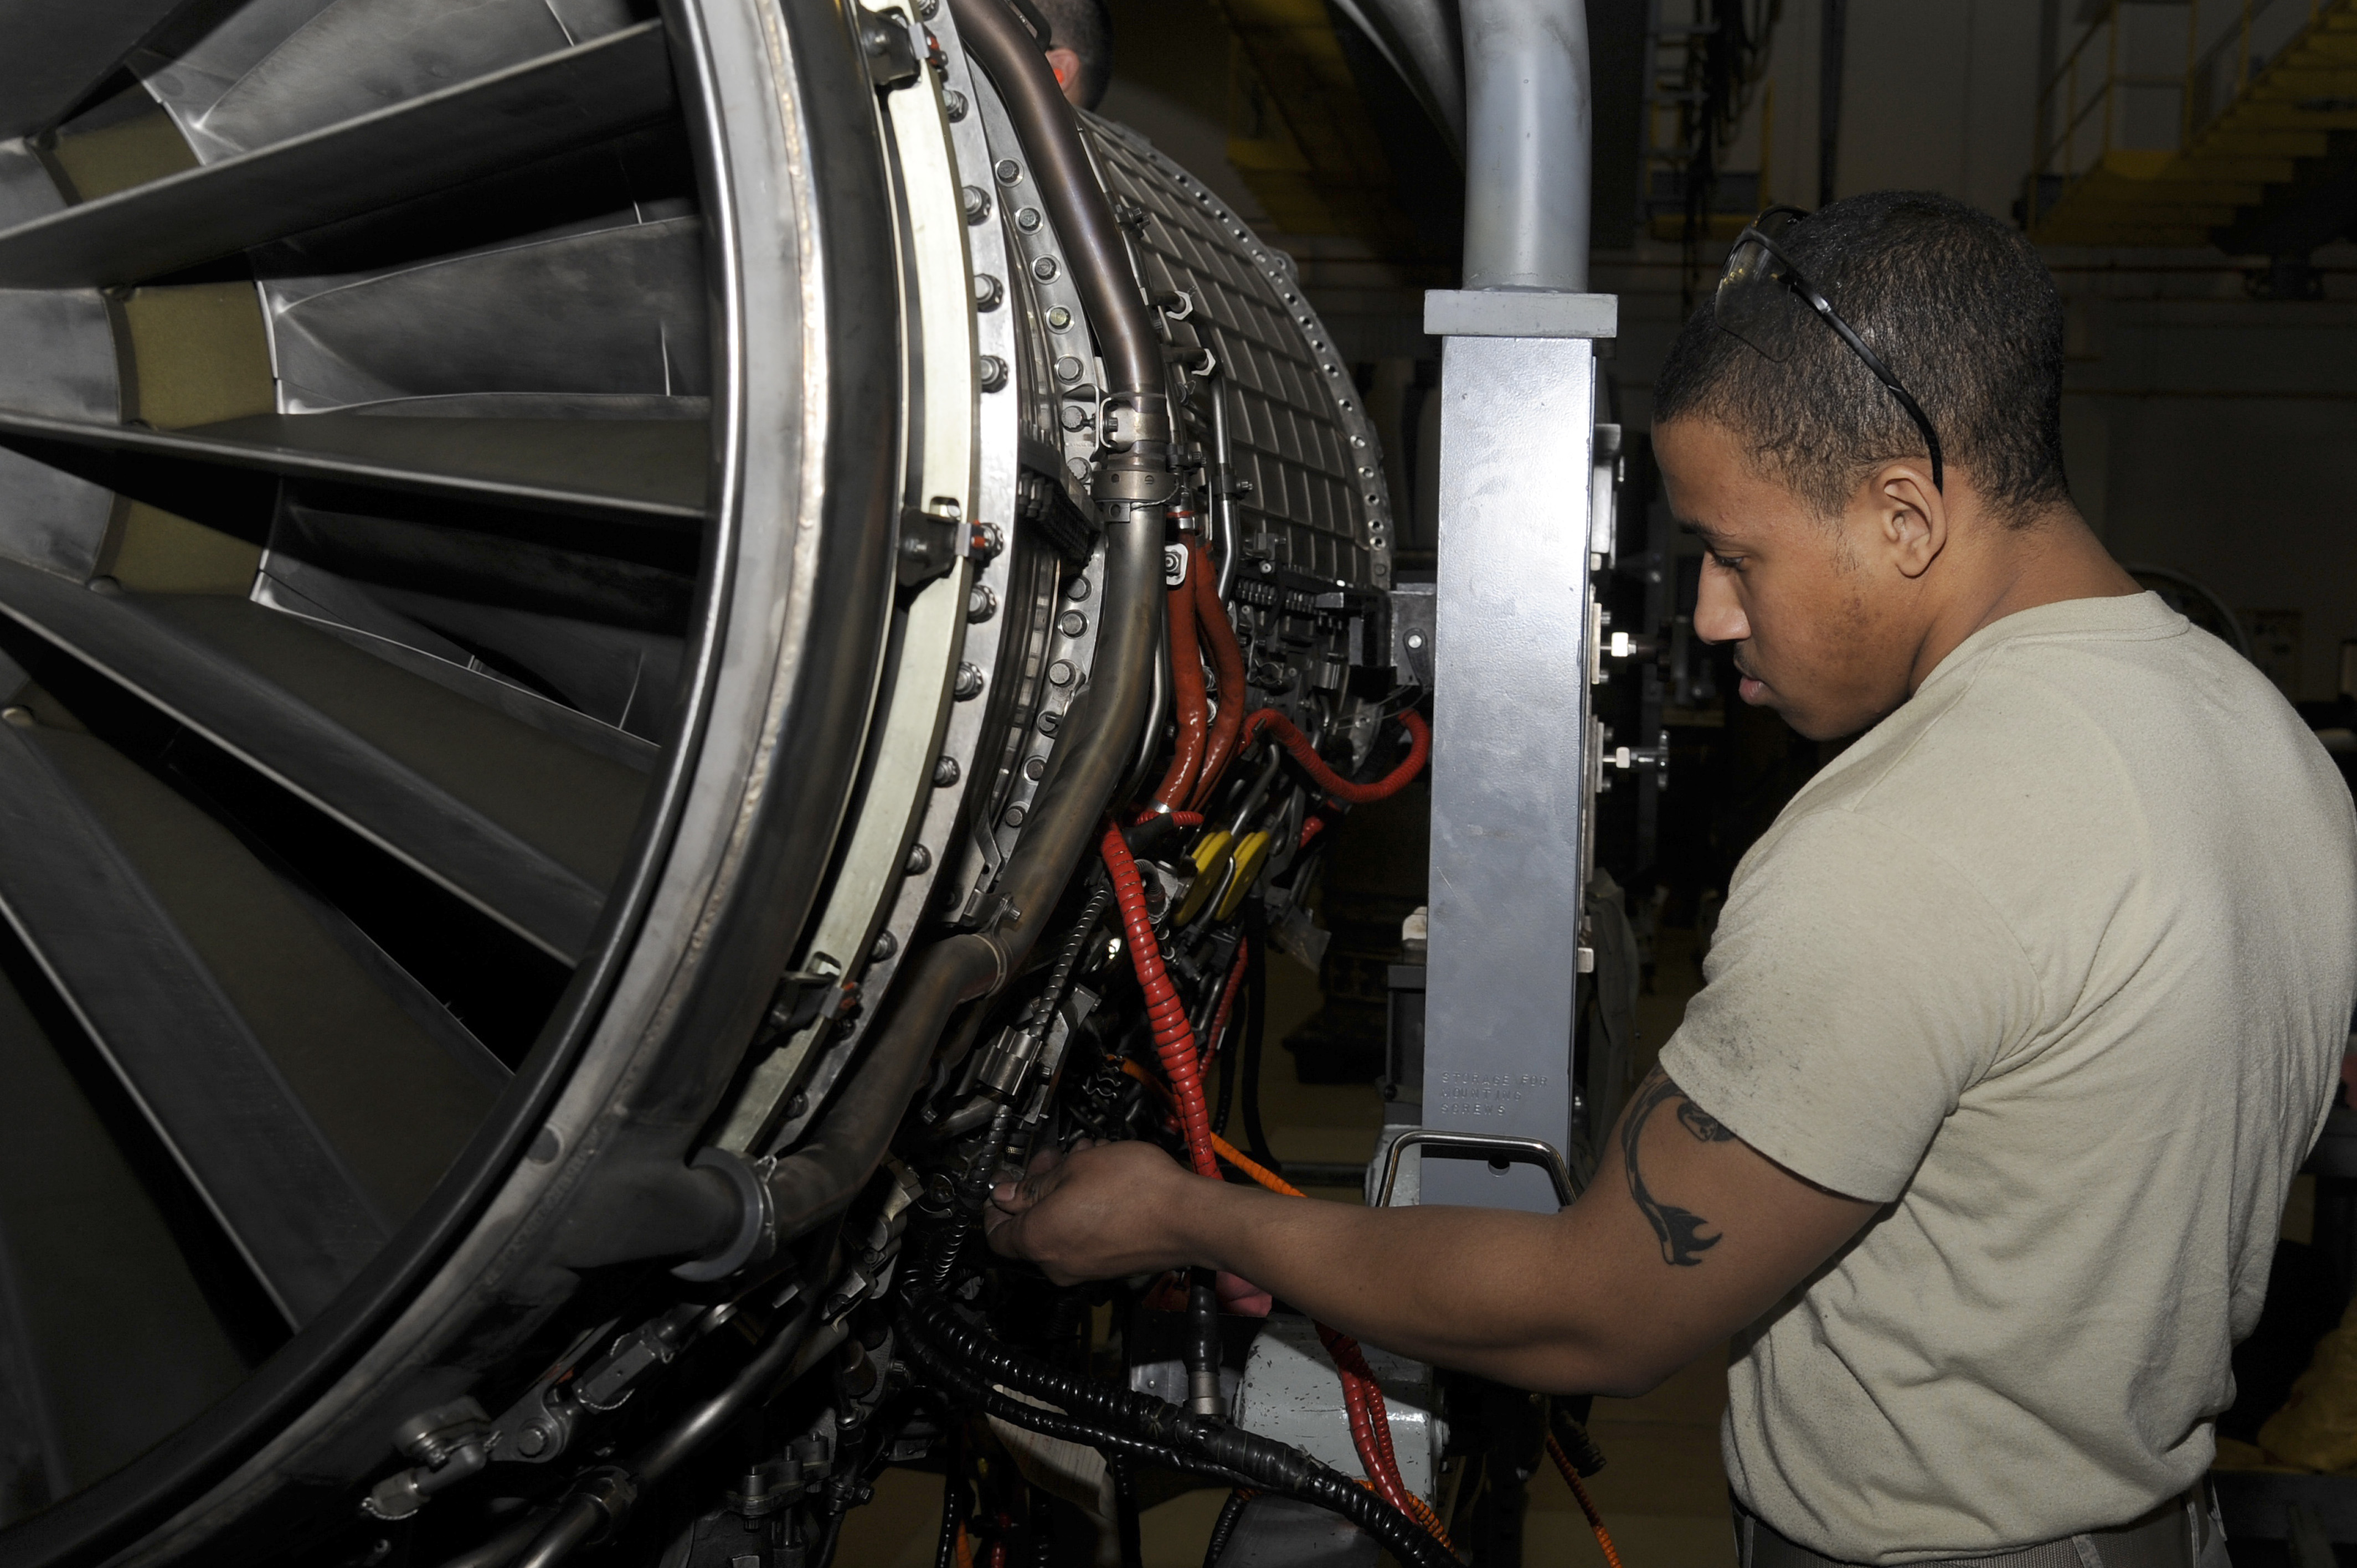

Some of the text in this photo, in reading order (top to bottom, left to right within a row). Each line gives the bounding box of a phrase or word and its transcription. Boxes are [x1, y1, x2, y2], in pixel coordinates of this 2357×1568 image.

[1441, 1072, 1548, 1088] STORAGE FOR
[1440, 1087, 1522, 1102] MOUNTING
[1440, 1102, 1506, 1116] SCREWS
